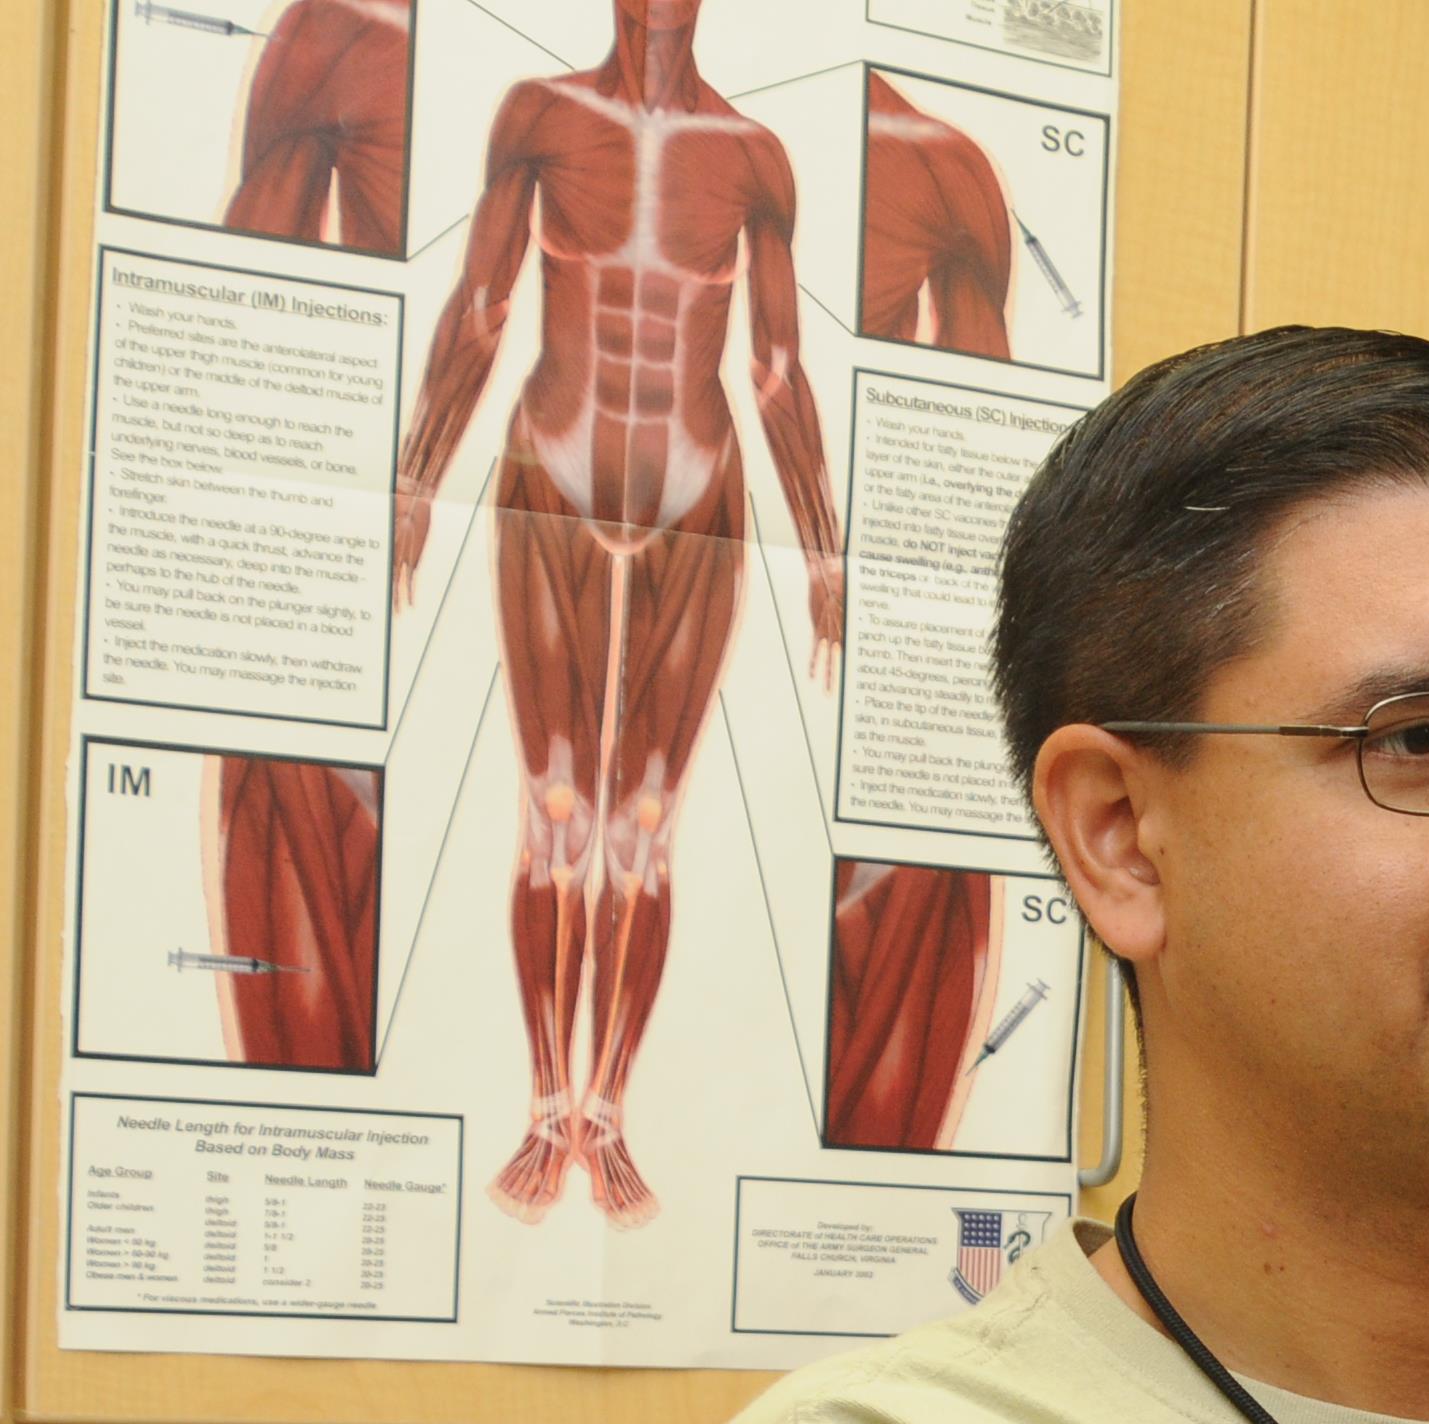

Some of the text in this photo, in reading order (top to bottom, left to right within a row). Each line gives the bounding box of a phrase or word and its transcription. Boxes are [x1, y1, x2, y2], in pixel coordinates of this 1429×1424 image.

[1041, 125, 1085, 157] SC
[113, 267, 387, 328] Intramuscular (IM) Injections:
[129, 303, 236, 329] Wash your hands.
[128, 321, 185, 339] Preferred
[187, 329, 215, 344] sites
[217, 336, 238, 347] are
[239, 337, 260, 350] the
[338, 352, 377, 371] aspect
[115, 337, 383, 388] of the upper thigh muscle (common for young
[113, 375, 199, 397] the upper arm.
[114, 357, 383, 404] children) or the middle of the deltoid muscle of
[866, 388, 1070, 436] Subcutaneous (SC) Injection
[108, 763, 151, 796] IM
[1022, 896, 1067, 924] SC
[117, 1116, 428, 1147] Needle Length for Intramuscular Injection
[195, 1140, 354, 1161] Based on Body Mass
[88, 1165, 152, 1180] Age Group
[206, 1171, 229, 1183] Site
[265, 1174, 347, 1190] Needle Length
[364, 1180, 402, 1193] Needle
[819, 1242, 844, 1251] ARMY
[823, 1232, 858, 1240] HEALTH
[859, 1233, 882, 1241] CARE
[884, 1234, 938, 1244] OPERATIONS
